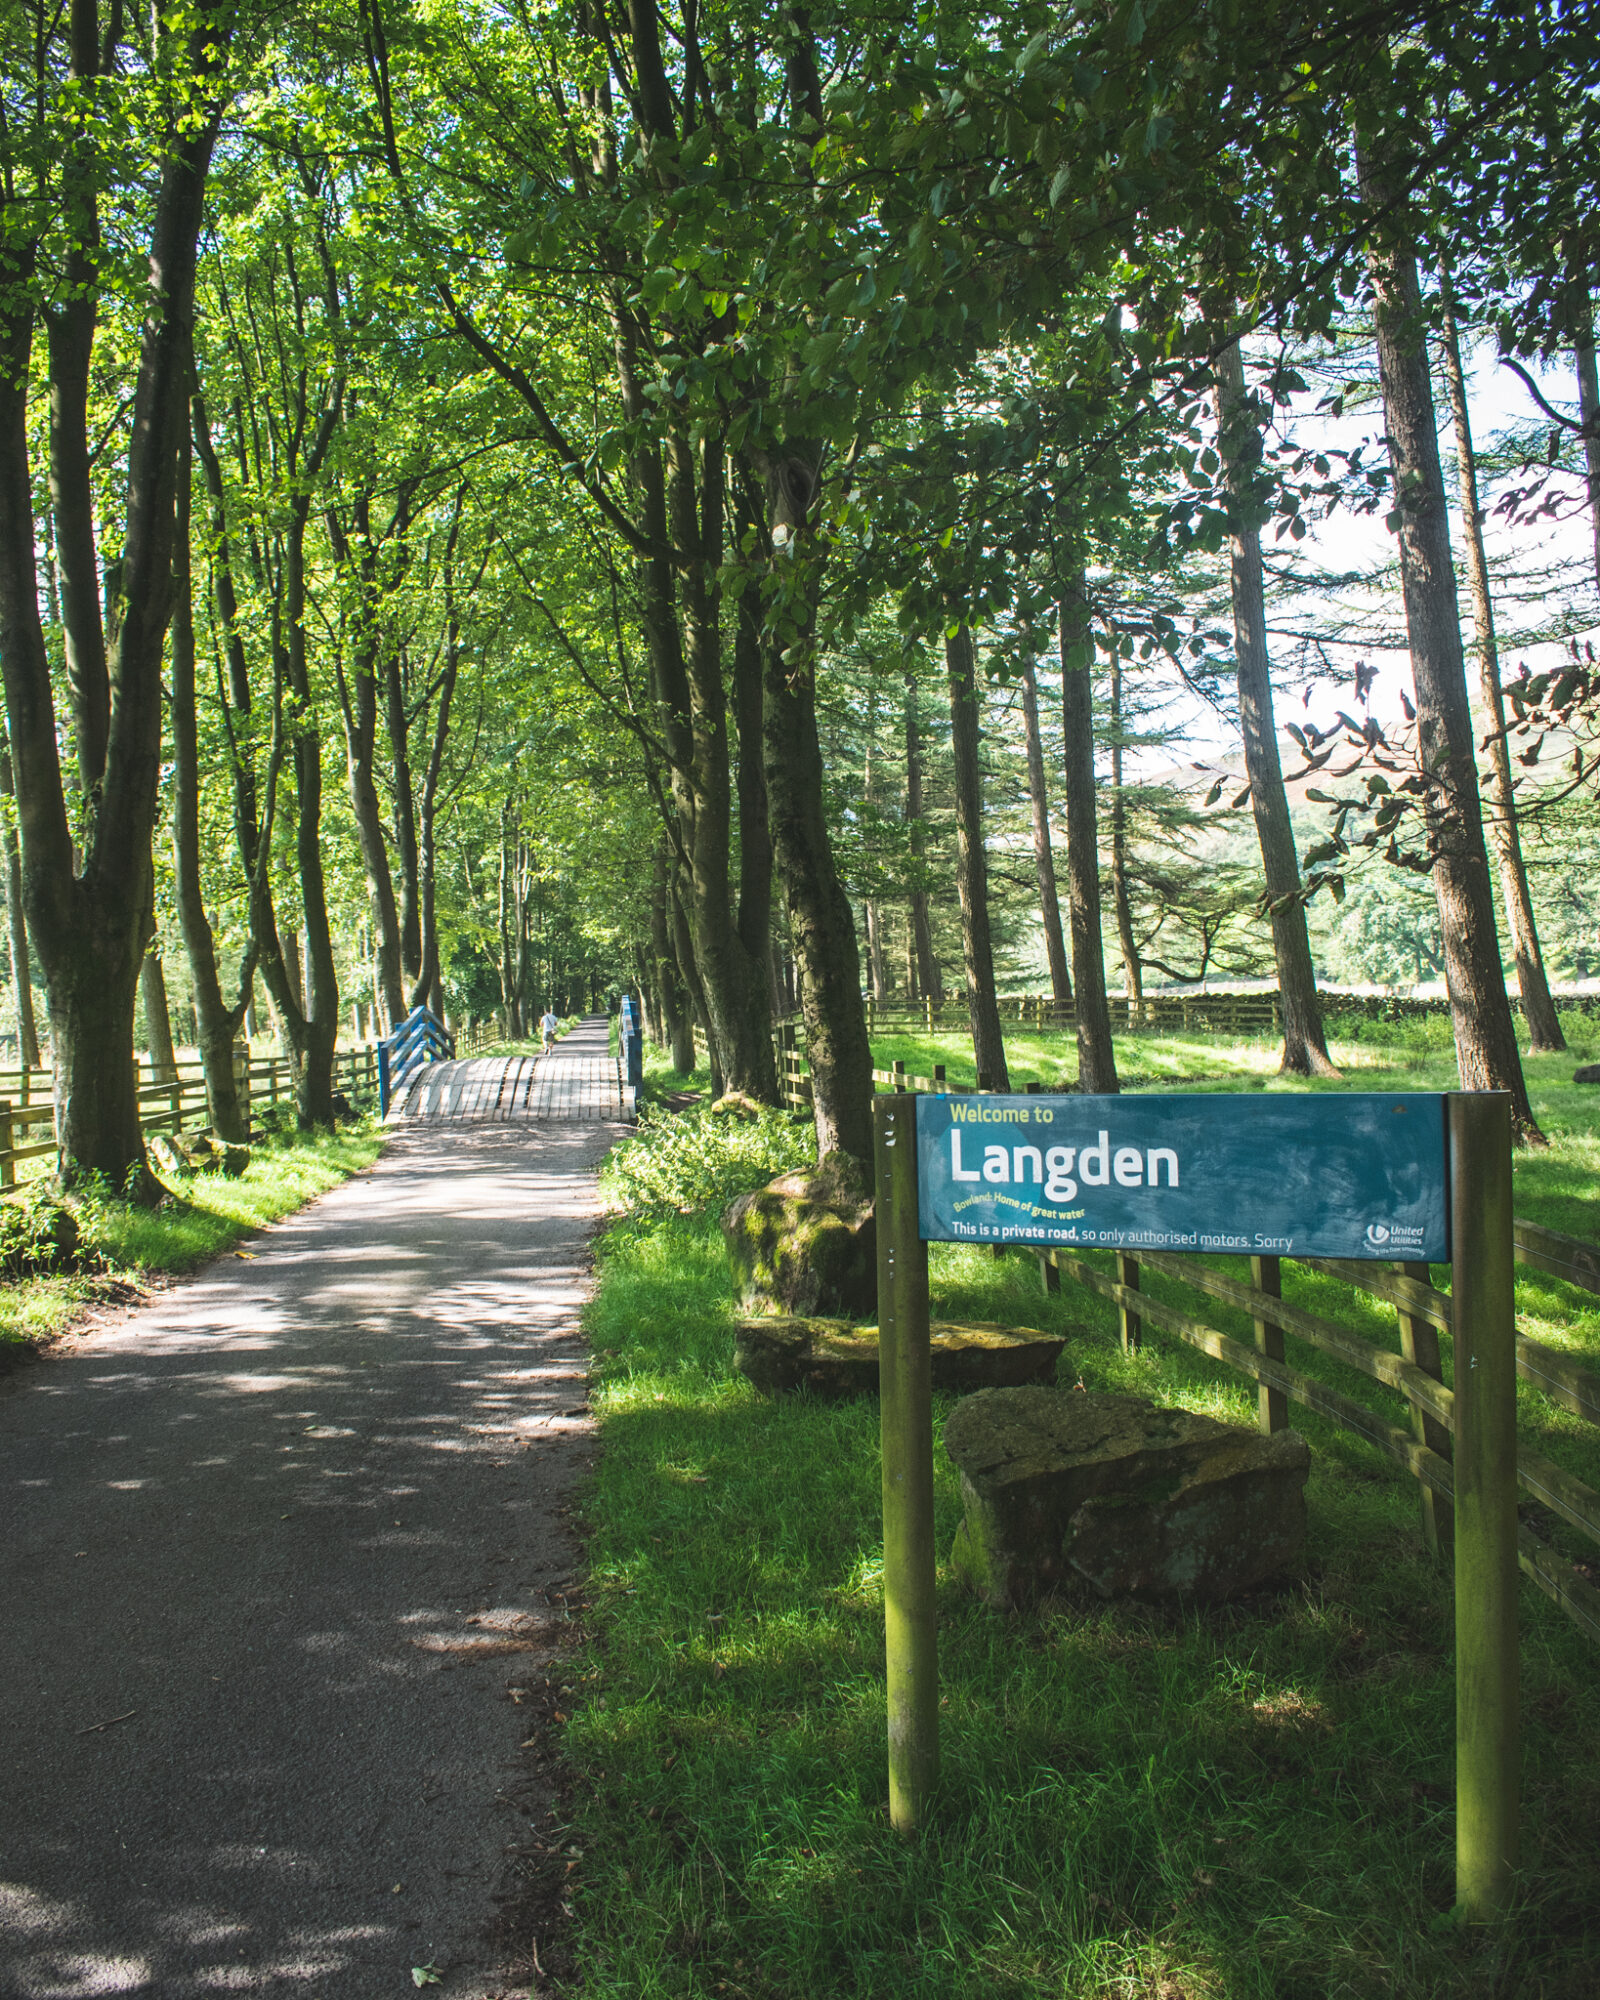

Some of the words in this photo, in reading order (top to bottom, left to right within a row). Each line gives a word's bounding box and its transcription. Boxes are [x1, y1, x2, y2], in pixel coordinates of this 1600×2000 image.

[950, 1104, 1029, 1123] Welcome
[1034, 1106, 1053, 1122] to
[951, 1129, 1179, 1202] Langden
[953, 1192, 992, 1212] Bowland:
[994, 1192, 1020, 1208] Home
[1021, 1202, 1032, 1211] of
[1031, 1206, 1057, 1219] great
[1058, 1208, 1085, 1220] water
[952, 1222, 977, 1235] This
[979, 1222, 989, 1235] is
[992, 1226, 999, 1236] a
[1002, 1224, 1045, 1239] private
[1048, 1226, 1079, 1240] road,
[1082, 1230, 1096, 1240] so
[1100, 1228, 1125, 1244] only
[1128, 1230, 1197, 1245] authorised
[1200, 1234, 1251, 1247] motors.
[1254, 1232, 1293, 1251] Sorry
[1390, 1225, 1424, 1236] United
[1390, 1236, 1422, 1245] Utilities
